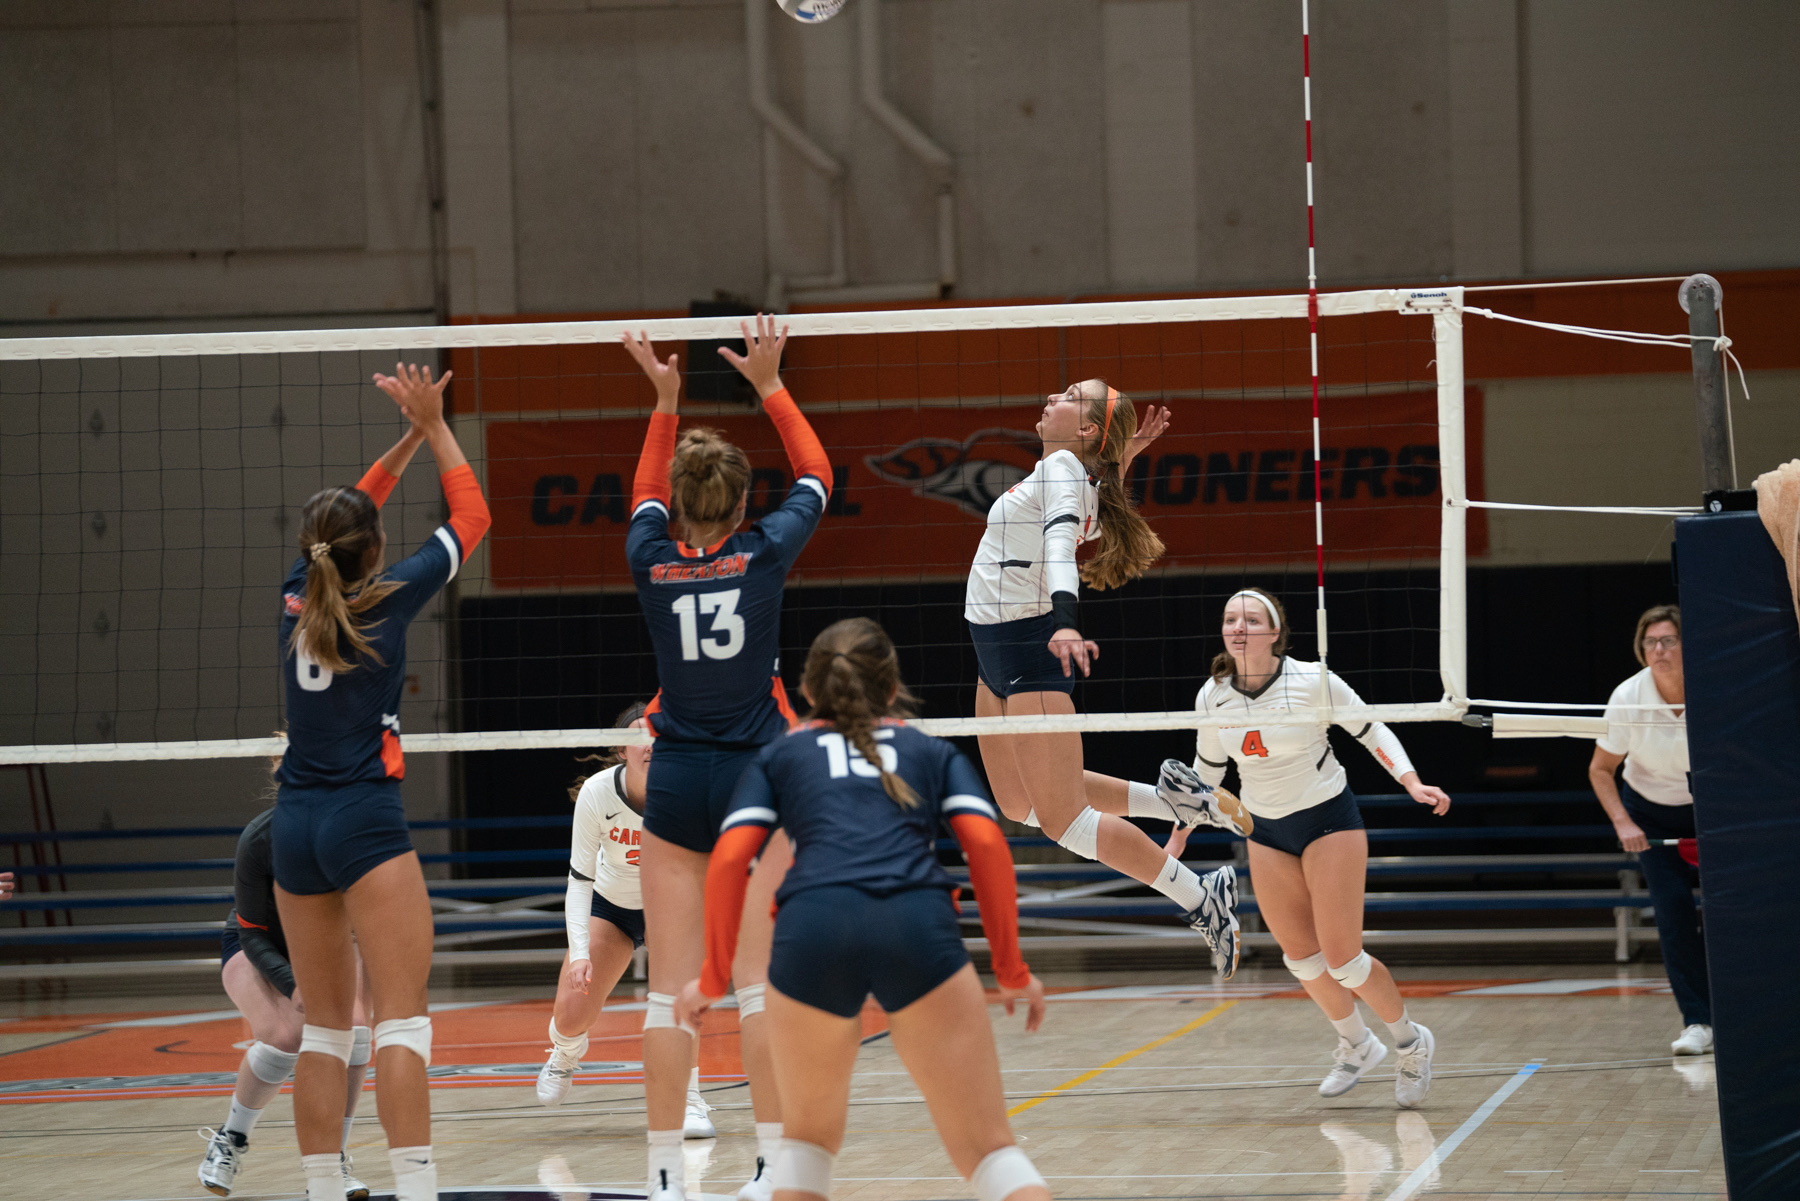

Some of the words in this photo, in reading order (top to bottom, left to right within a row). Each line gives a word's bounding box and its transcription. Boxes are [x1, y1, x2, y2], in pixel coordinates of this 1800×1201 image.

[531, 465, 862, 526] CAOL
[1130, 445, 1440, 505] IONEERS
[651, 553, 752, 584] WHEATON
[672, 588, 745, 660] 13
[816, 728, 898, 778] 15
[1241, 730, 1269, 757] 4
